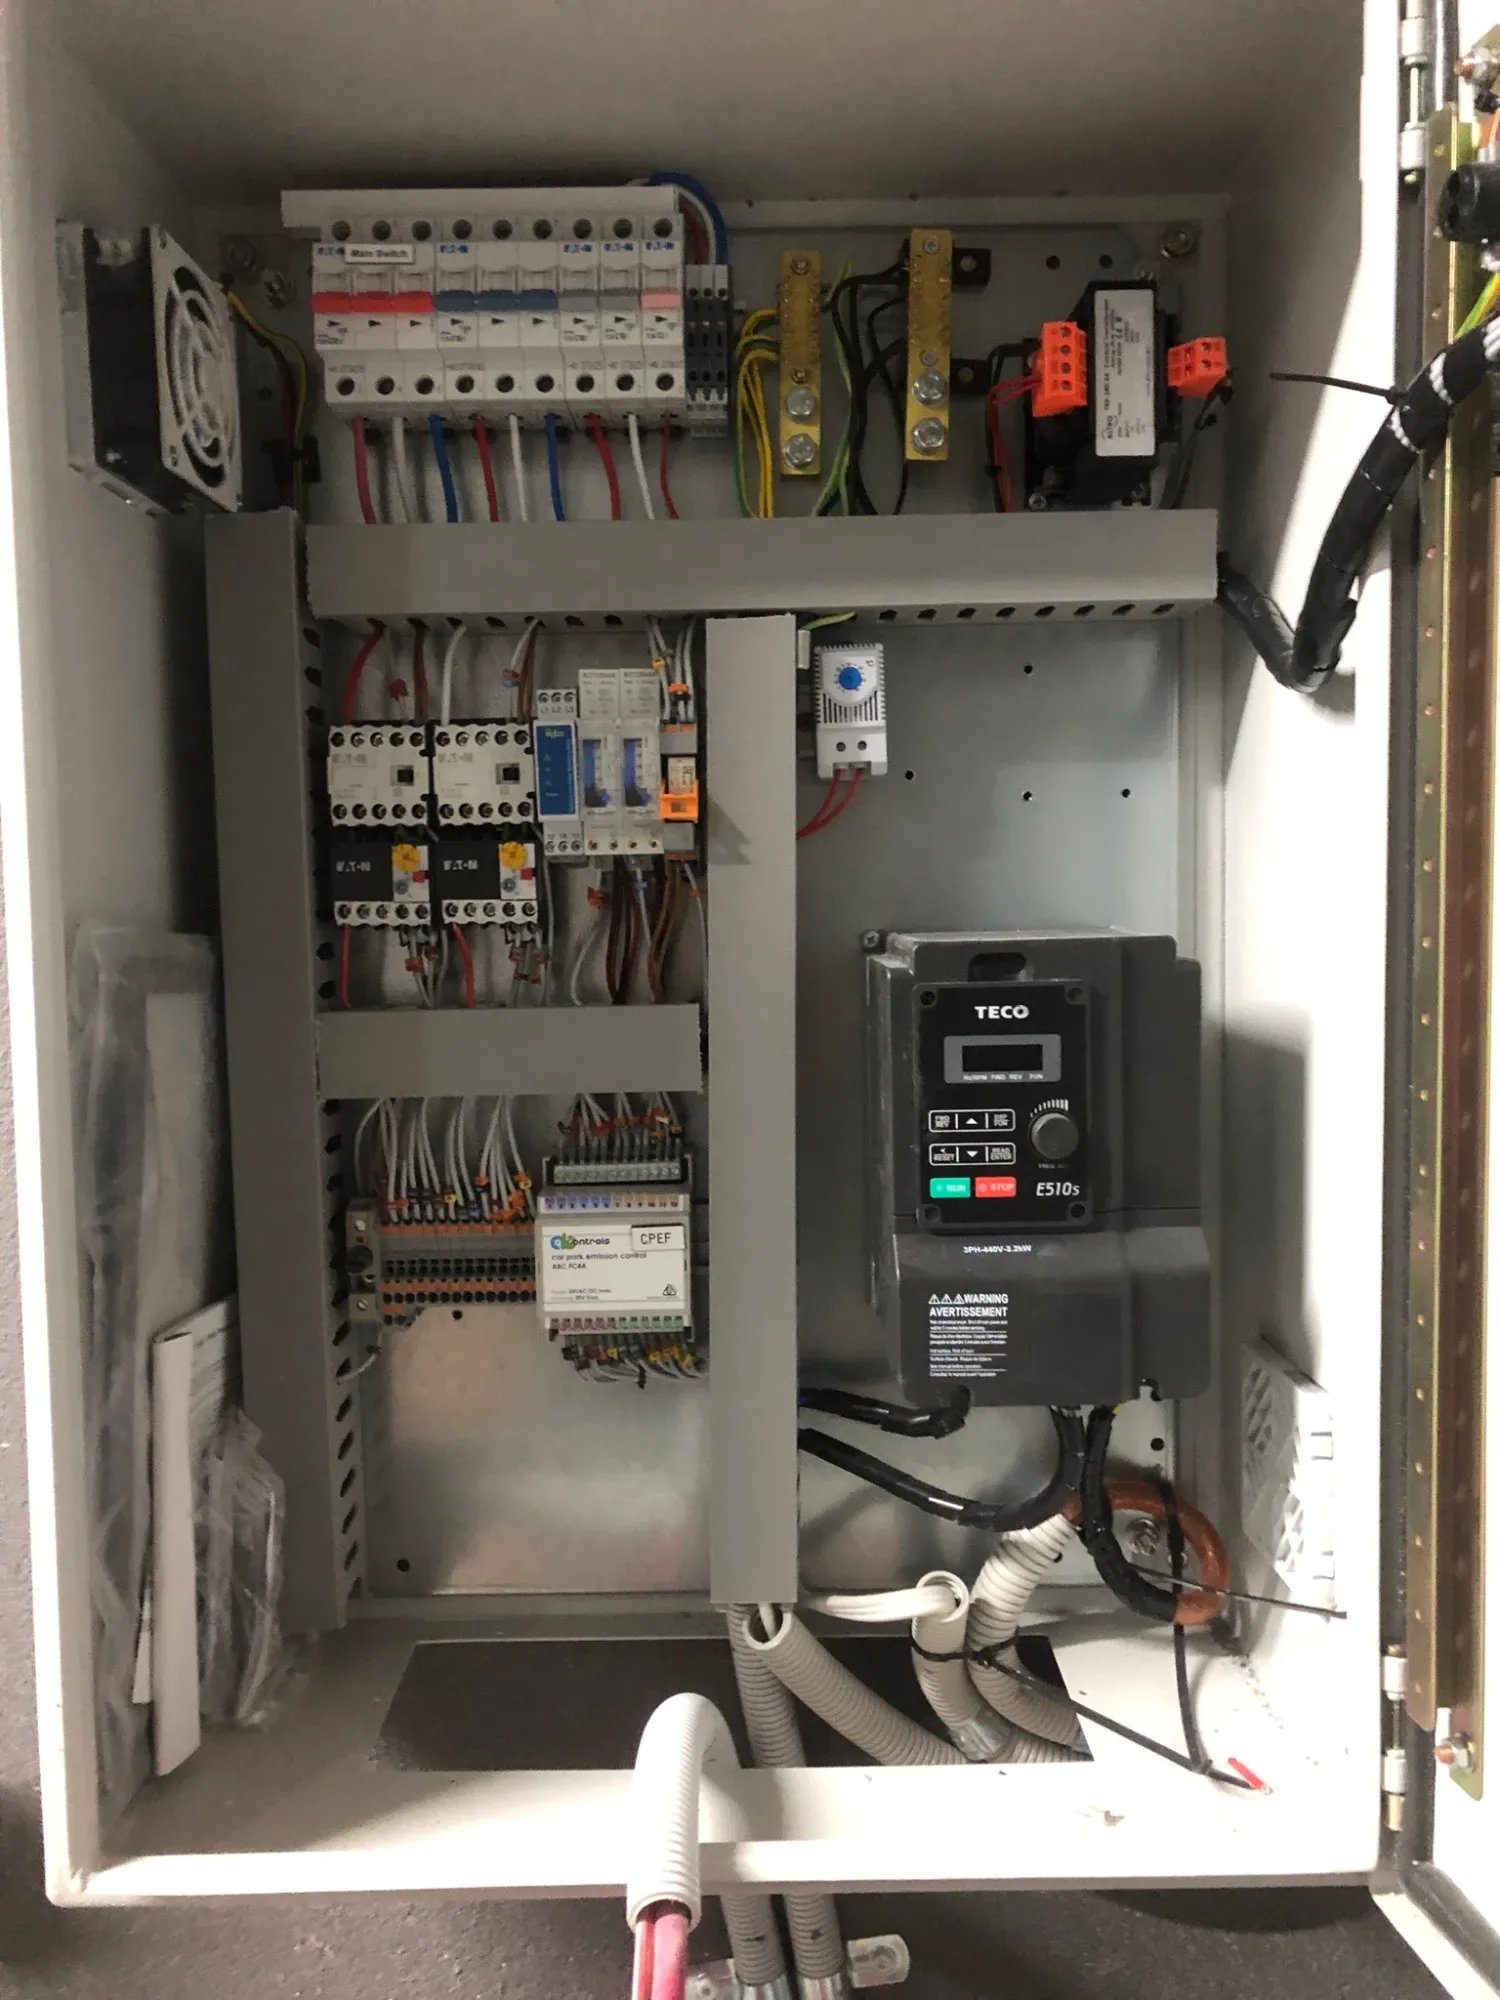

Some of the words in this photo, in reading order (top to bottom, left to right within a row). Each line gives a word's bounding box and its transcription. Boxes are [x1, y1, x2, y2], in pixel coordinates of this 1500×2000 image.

[350, 249, 373, 259] Main
[375, 248, 408, 259] Switch
[974, 1004, 1030, 1019] TECO
[992, 1185, 1017, 1194] STOP
[1035, 1181, 1081, 1197] E510s
[640, 1232, 671, 1246] CPEF
[566, 1253, 584, 1263] park
[585, 1252, 618, 1261] emission
[620, 1251, 647, 1260] control
[963, 1293, 1009, 1304] WARNING
[929, 1307, 1008, 1317] AVERTISSEMENT
